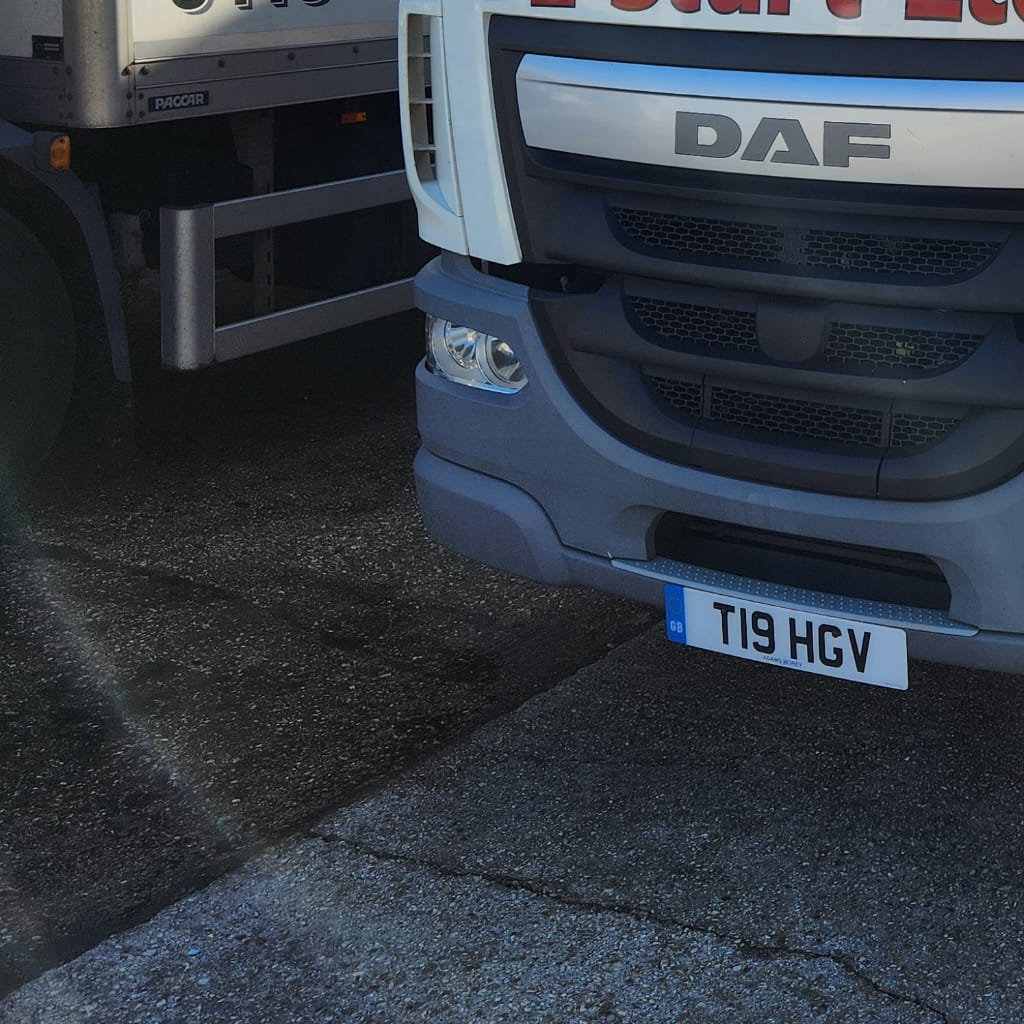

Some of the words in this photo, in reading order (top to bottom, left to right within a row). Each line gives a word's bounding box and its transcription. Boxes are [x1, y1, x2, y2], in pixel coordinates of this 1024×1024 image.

[155, 93, 205, 110] PACCAR
[675, 110, 892, 168] DAF
[669, 619, 684, 634] GB
[713, 601, 776, 655] T19
[789, 617, 872, 674] HGV
